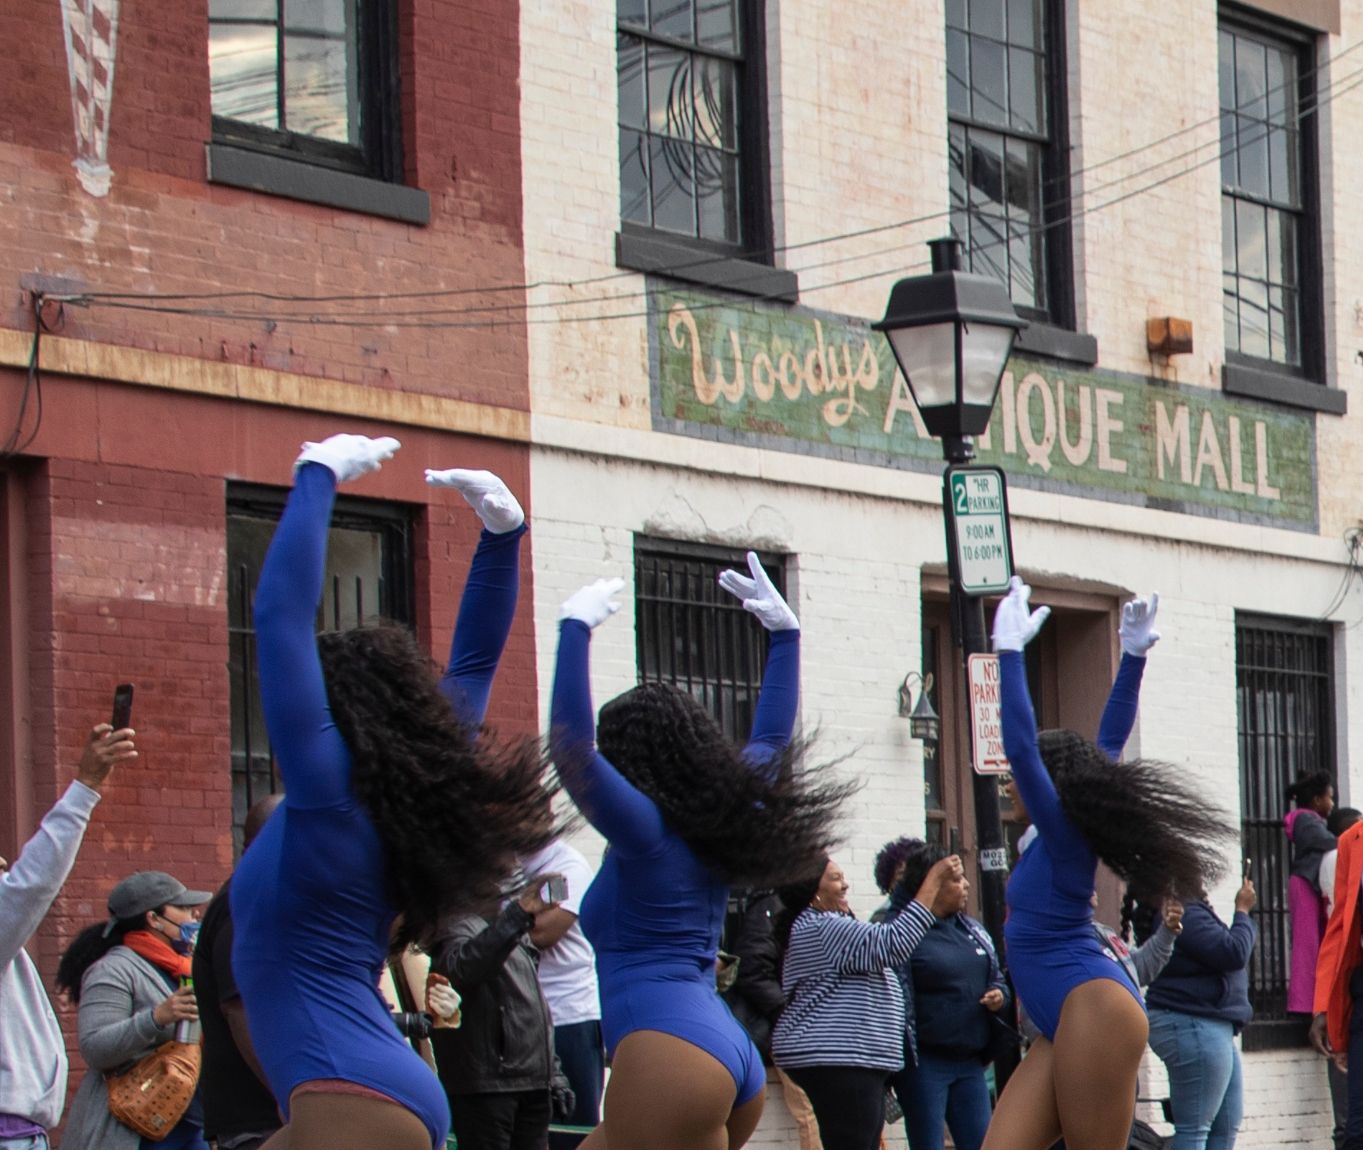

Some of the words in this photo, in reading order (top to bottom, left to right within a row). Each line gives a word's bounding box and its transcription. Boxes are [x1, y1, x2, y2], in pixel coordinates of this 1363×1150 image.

[884, 367, 1128, 474] AIQUE
[1155, 400, 1282, 500] MALL
[955, 482, 967, 512] 2
[969, 496, 1000, 511] PARKING
[963, 545, 972, 560] TO
[983, 662, 998, 682] NO
[975, 684, 1000, 705] PARKI
[980, 707, 989, 721] 30
[979, 724, 1002, 739] LOADI
[987, 740, 1005, 756] ZON
